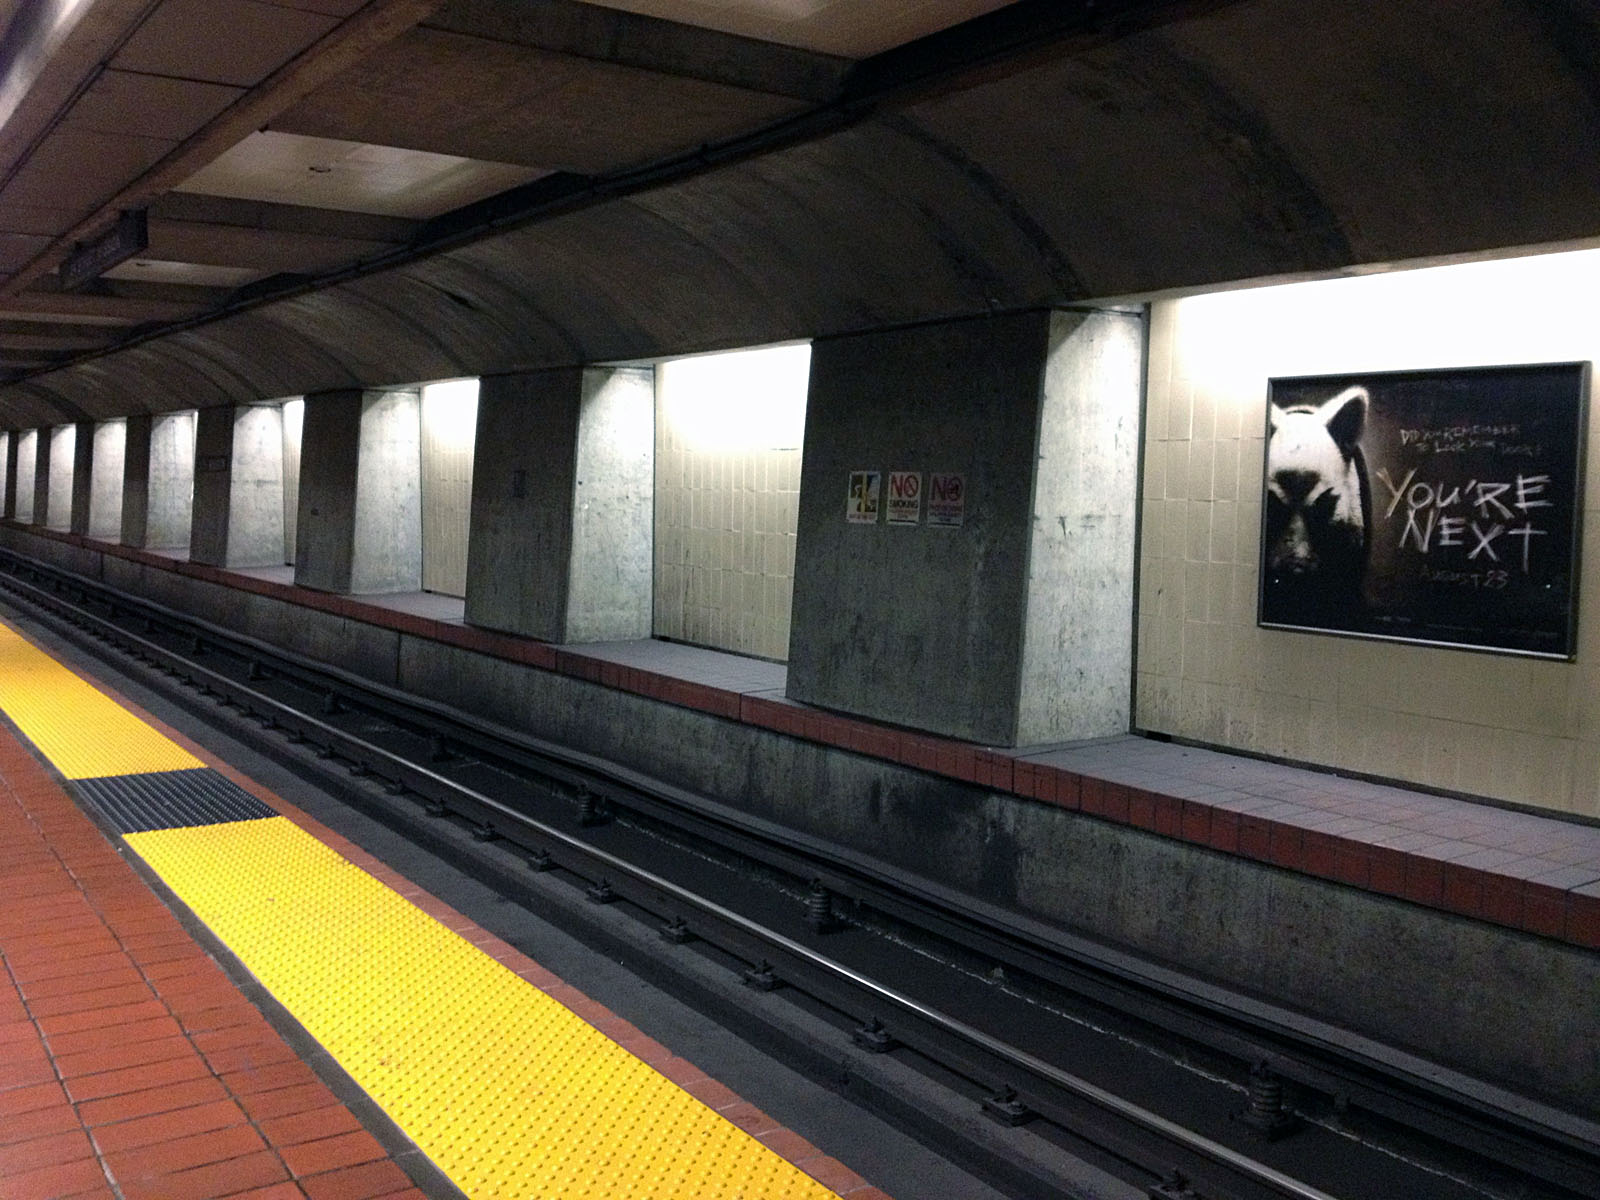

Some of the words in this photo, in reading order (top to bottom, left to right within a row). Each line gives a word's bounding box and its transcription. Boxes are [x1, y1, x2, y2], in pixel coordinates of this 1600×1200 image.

[890, 474, 919, 498] NO
[931, 476, 963, 501] NO
[1376, 467, 1554, 519] YOU'RE
[889, 499, 919, 509] SMOKING
[1398, 508, 1548, 575] NEXT
[1483, 569, 1509, 590] 23
